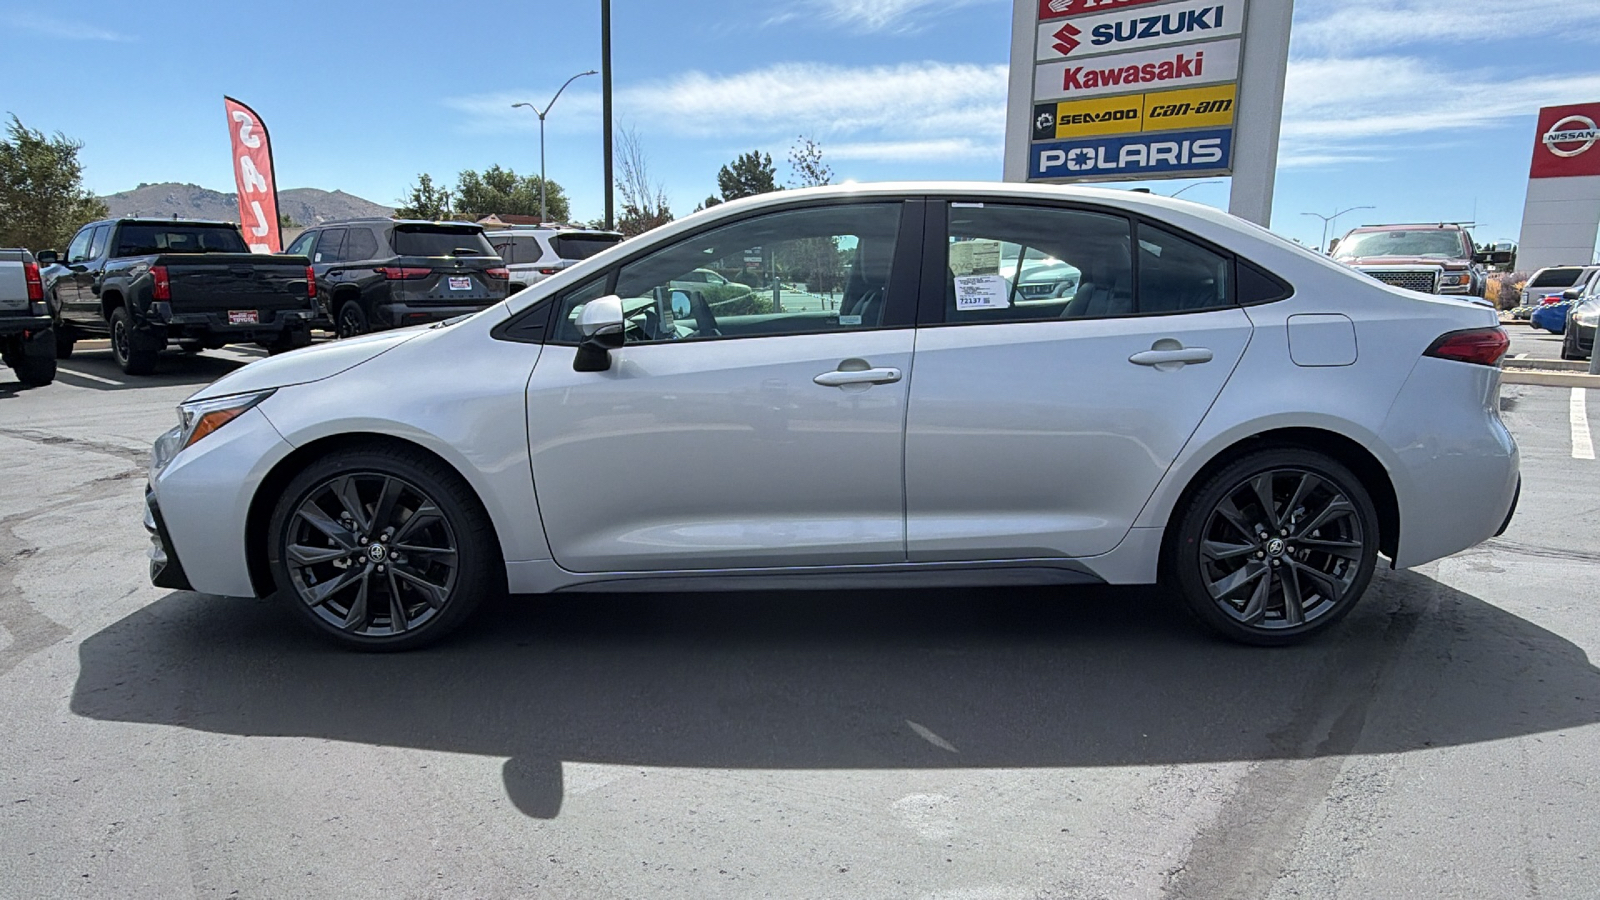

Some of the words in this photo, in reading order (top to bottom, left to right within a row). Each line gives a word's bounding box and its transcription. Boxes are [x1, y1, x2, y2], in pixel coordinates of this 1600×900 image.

[1091, 5, 1224, 46] SUZUKI
[1063, 51, 1204, 91] Kawasaki
[1547, 131, 1595, 141] NISSAN
[1039, 138, 1223, 173] POLARIS
